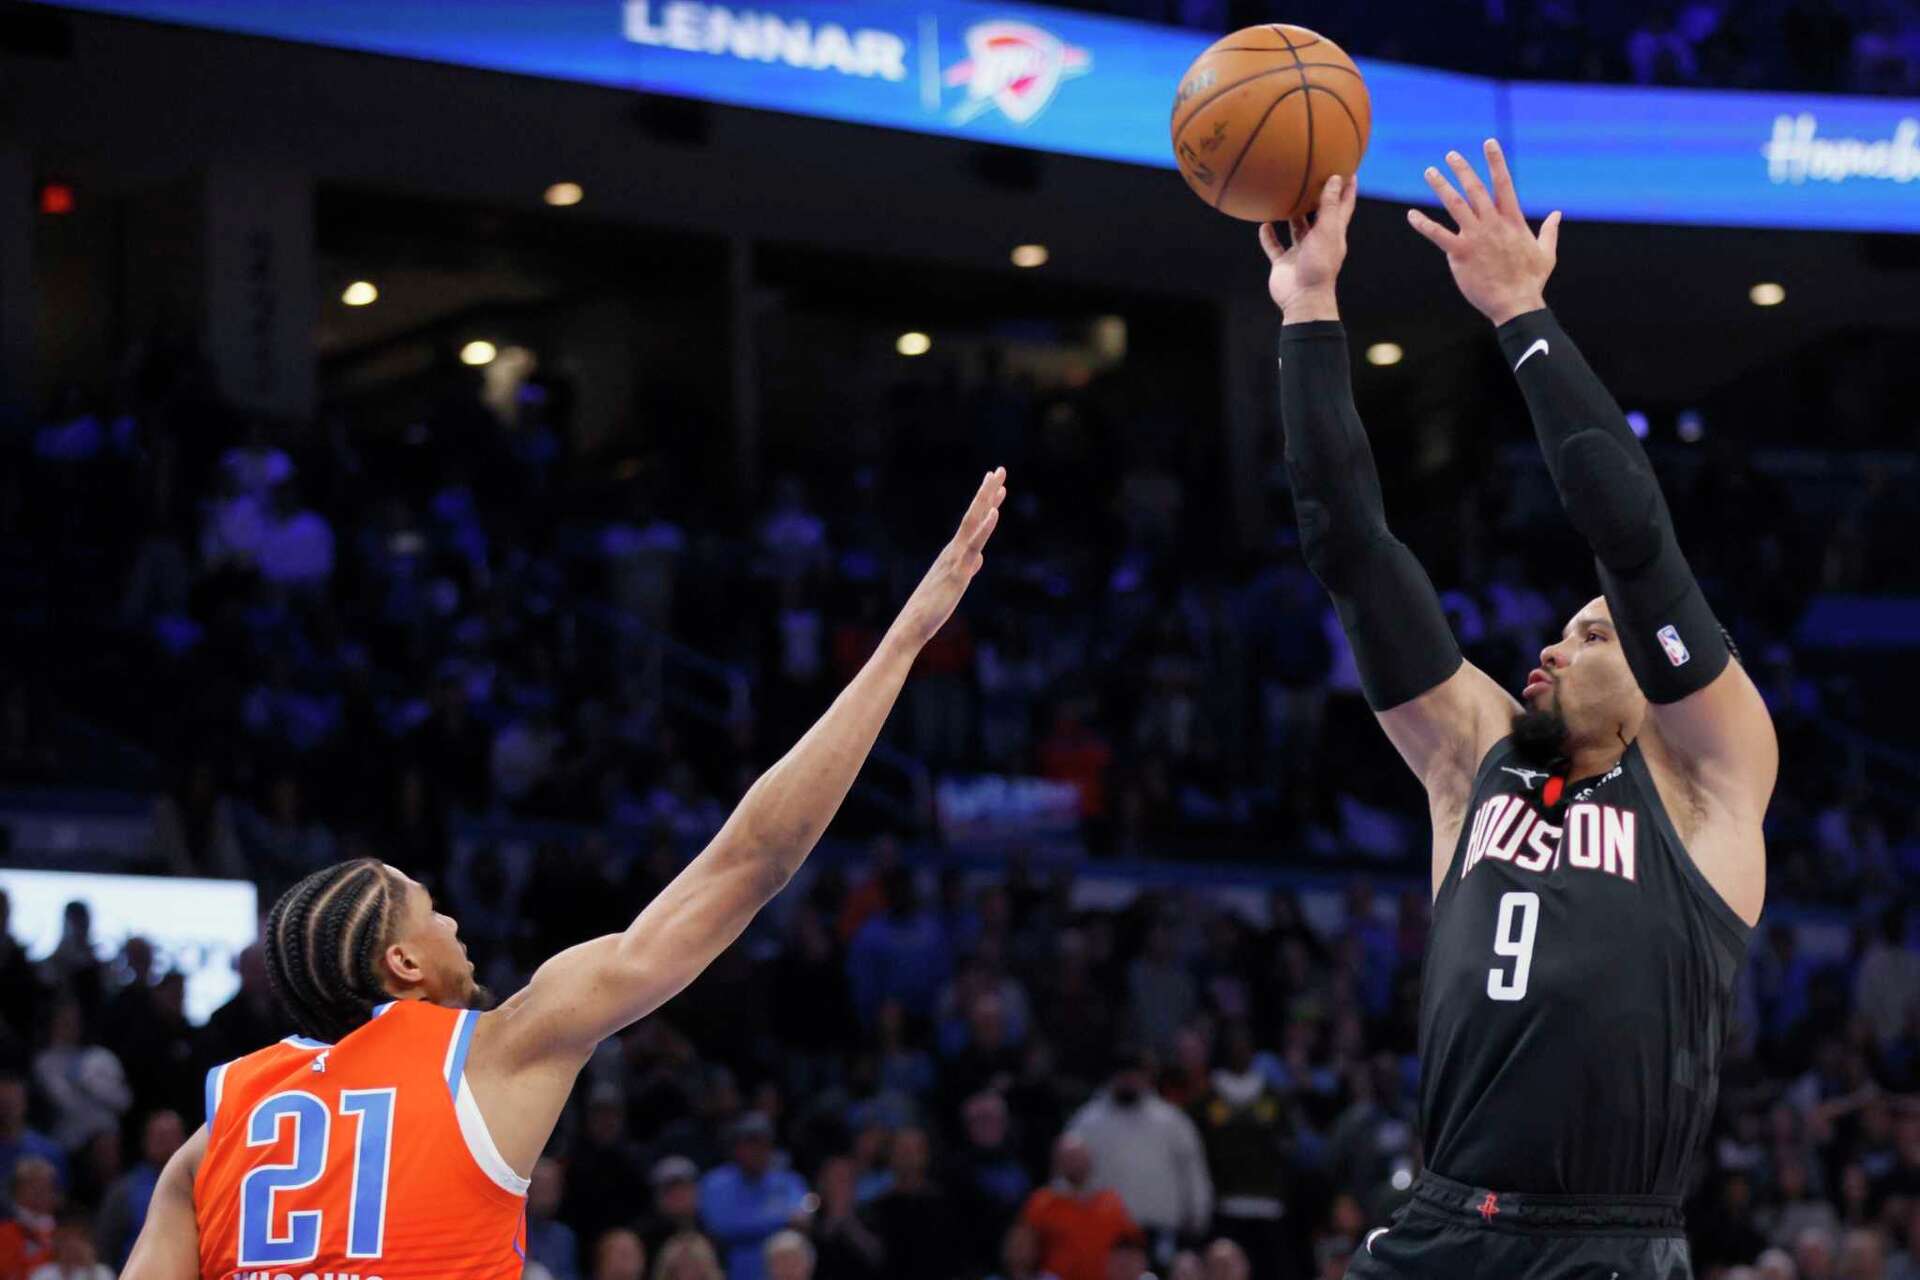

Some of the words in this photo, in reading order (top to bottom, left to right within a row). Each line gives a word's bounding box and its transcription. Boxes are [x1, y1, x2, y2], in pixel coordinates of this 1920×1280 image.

[624, 0, 906, 81] LENNAR
[1487, 892, 1539, 1001] 9
[237, 1087, 397, 1267] 21
